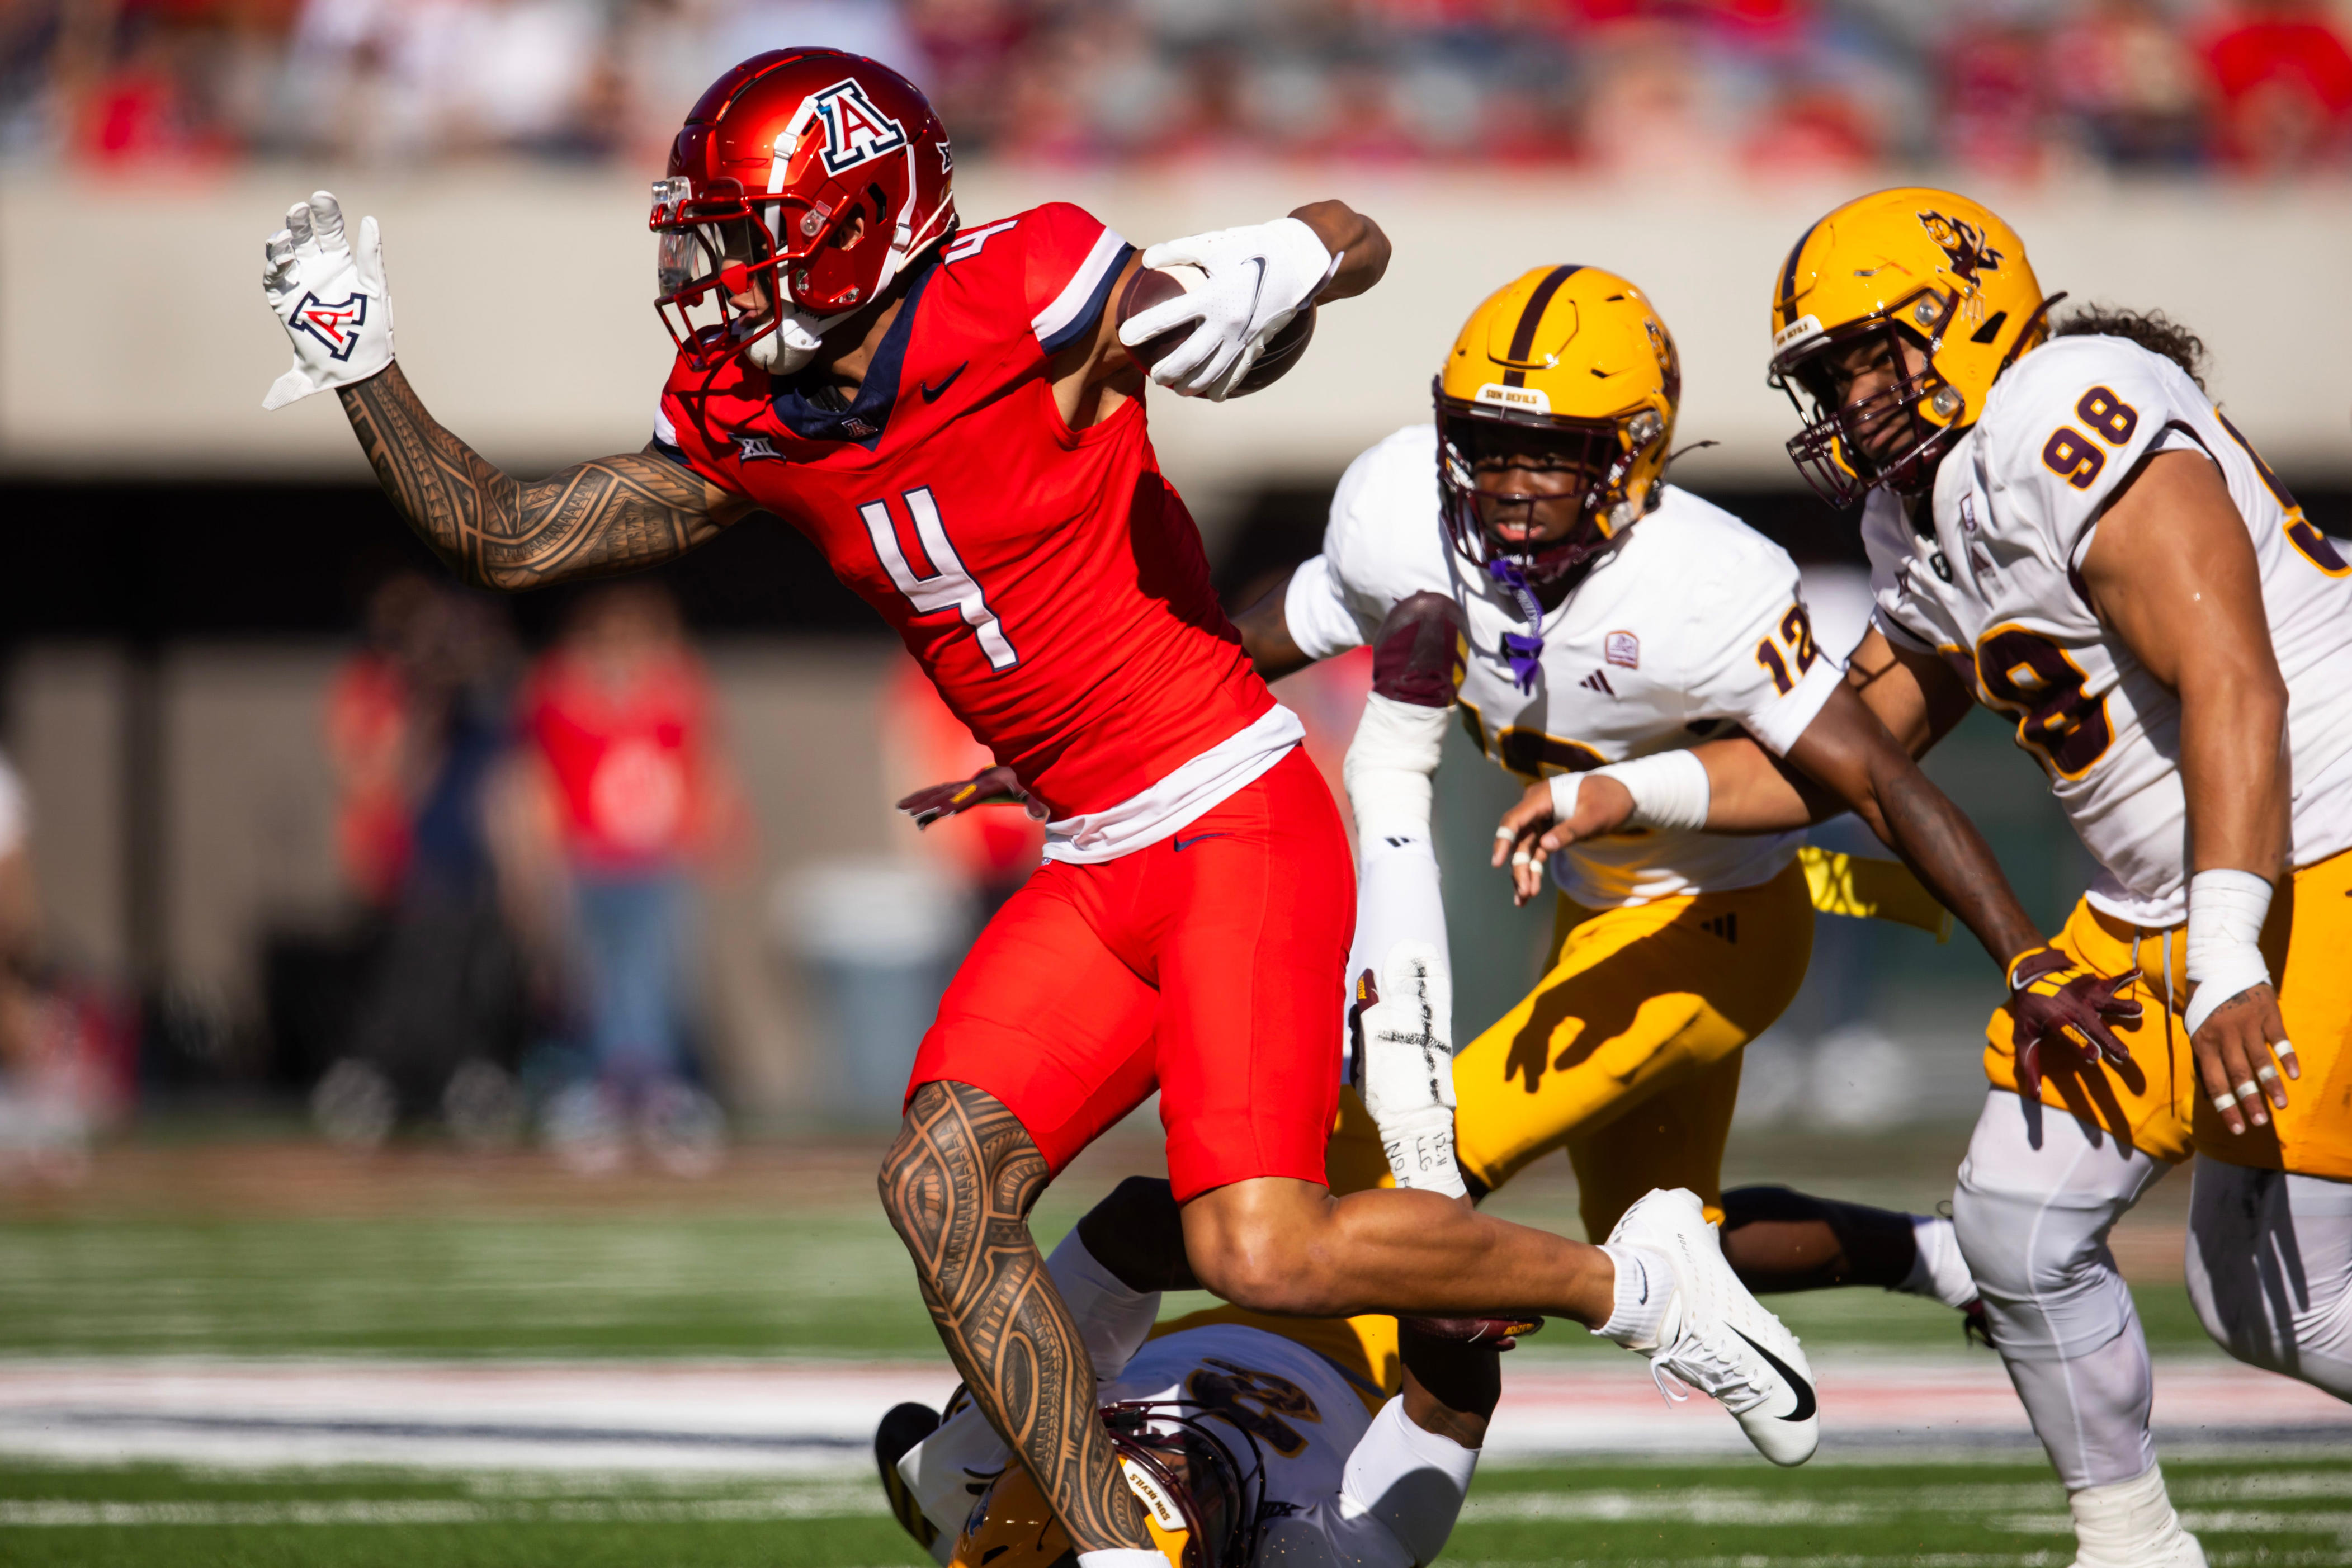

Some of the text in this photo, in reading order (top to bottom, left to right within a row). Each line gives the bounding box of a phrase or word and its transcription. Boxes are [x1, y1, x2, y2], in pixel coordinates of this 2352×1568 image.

[808, 77, 907, 177] A
[944, 220, 1021, 267] 4
[288, 290, 367, 362] A
[841, 418, 879, 438] A
[1485, 389, 1537, 404] SUN DEVILS
[2041, 385, 2139, 491] 98
[857, 484, 1019, 673] 4
[1755, 603, 1819, 697] 12
[1129, 1473, 1171, 1522] SUN DEVILS
